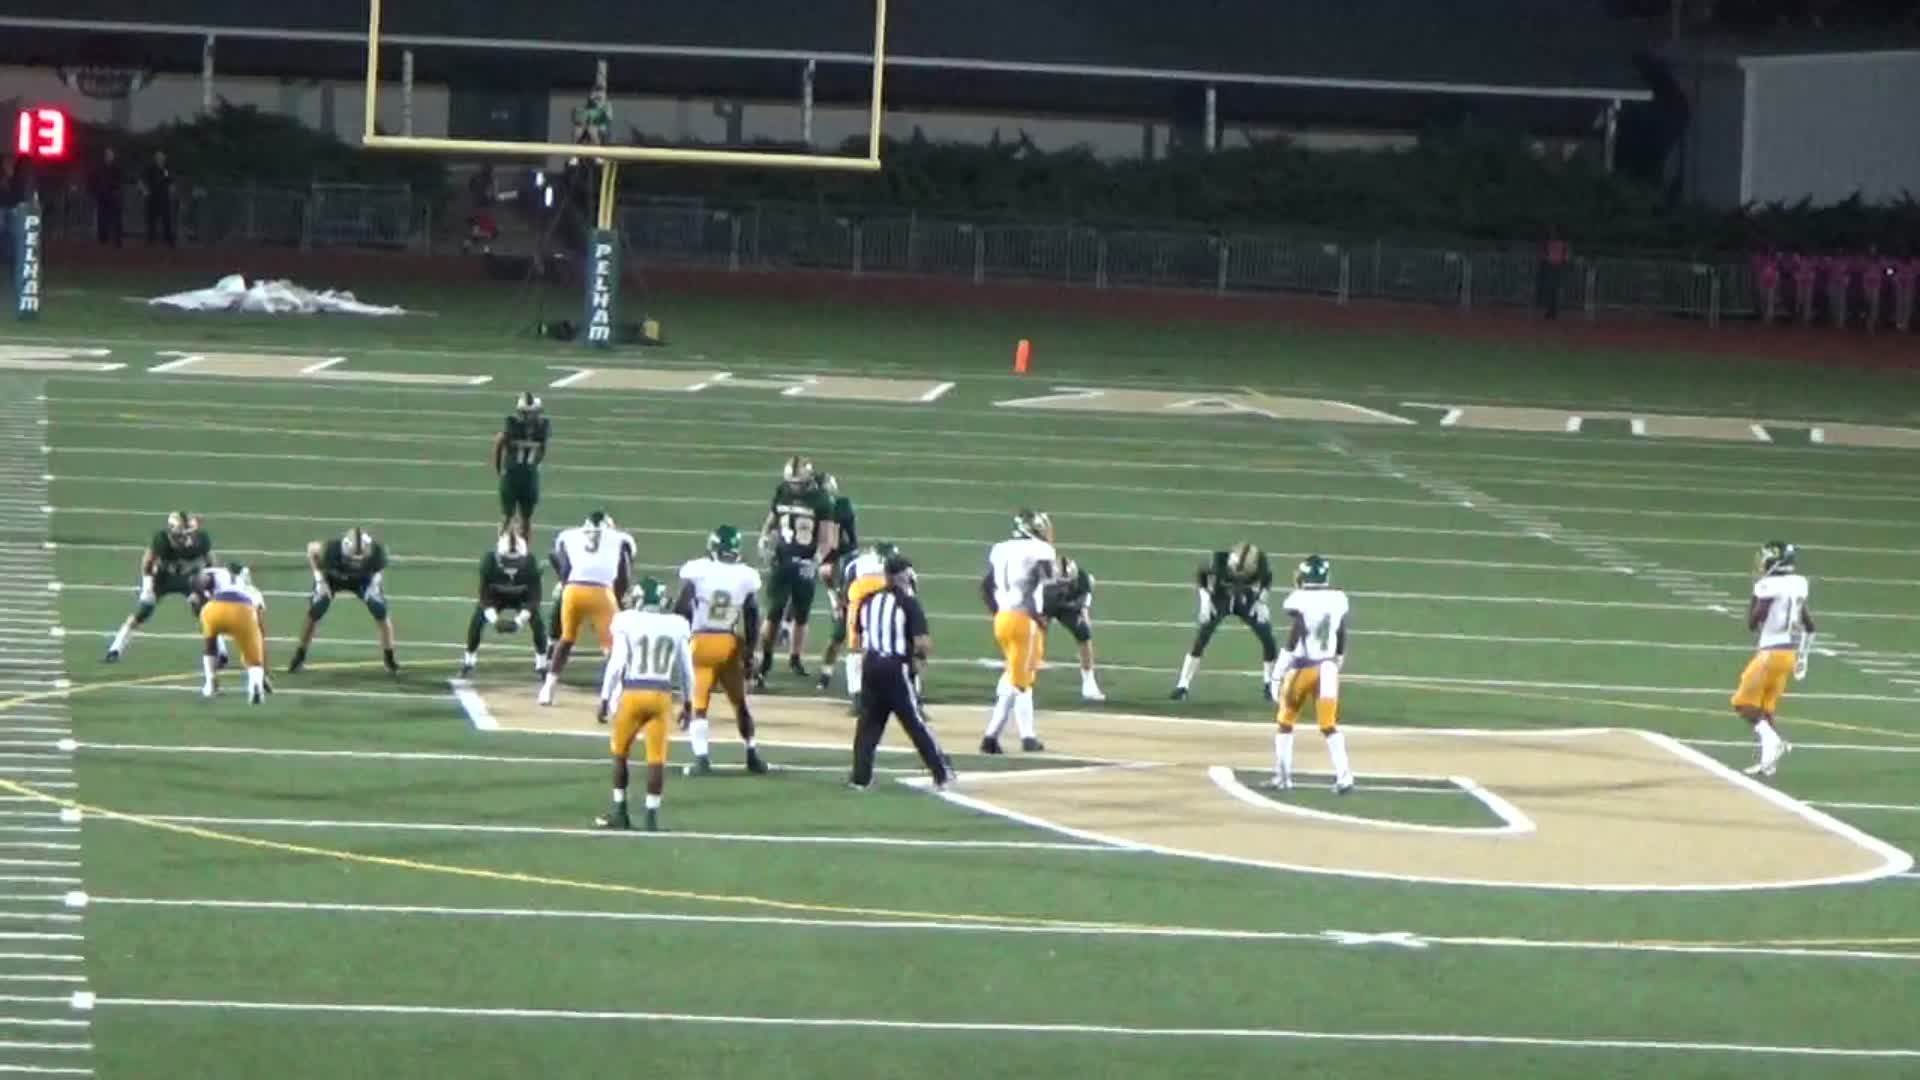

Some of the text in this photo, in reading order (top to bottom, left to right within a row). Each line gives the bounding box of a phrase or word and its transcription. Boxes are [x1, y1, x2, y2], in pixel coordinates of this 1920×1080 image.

[19, 109, 64, 154] 13
[20, 214, 40, 312] PELHAM
[589, 243, 612, 340] PELHAM
[582, 529, 602, 554] 3
[636, 634, 674, 675] 10
